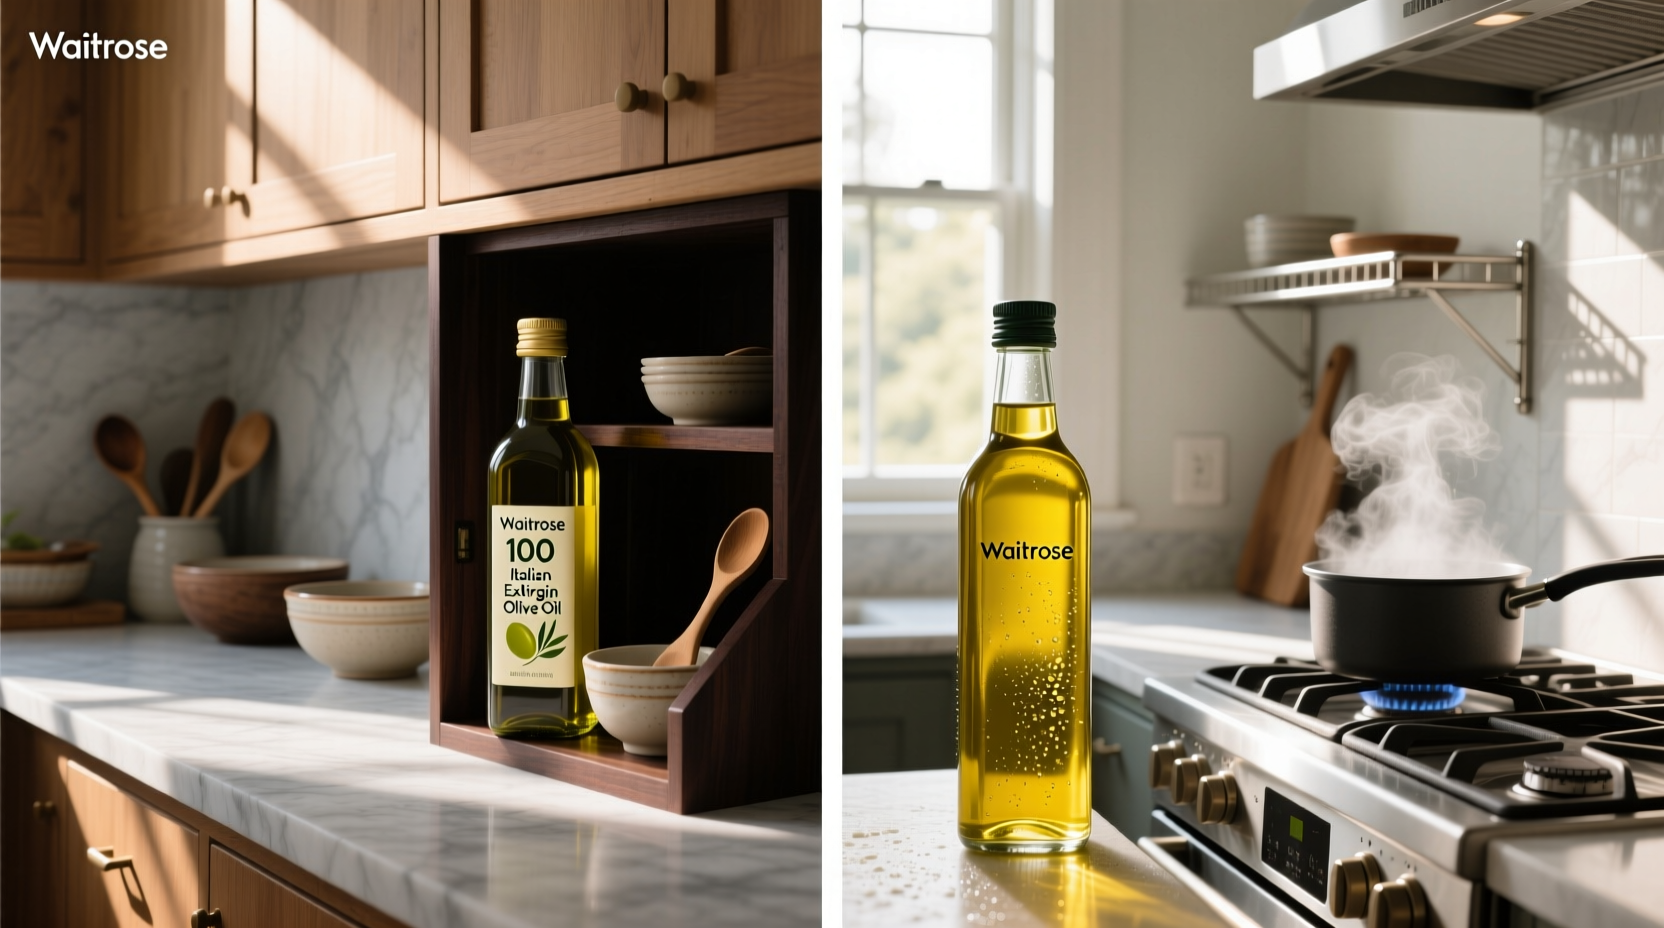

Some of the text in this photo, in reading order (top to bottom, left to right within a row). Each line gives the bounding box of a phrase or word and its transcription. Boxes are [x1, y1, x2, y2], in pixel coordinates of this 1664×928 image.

[500, 516, 565, 531] Waitrose
[506, 538, 555, 563] 100
[980, 540, 1074, 560] Waitrose
[510, 567, 552, 581] Italian
[503, 600, 562, 615] Olive Oil
